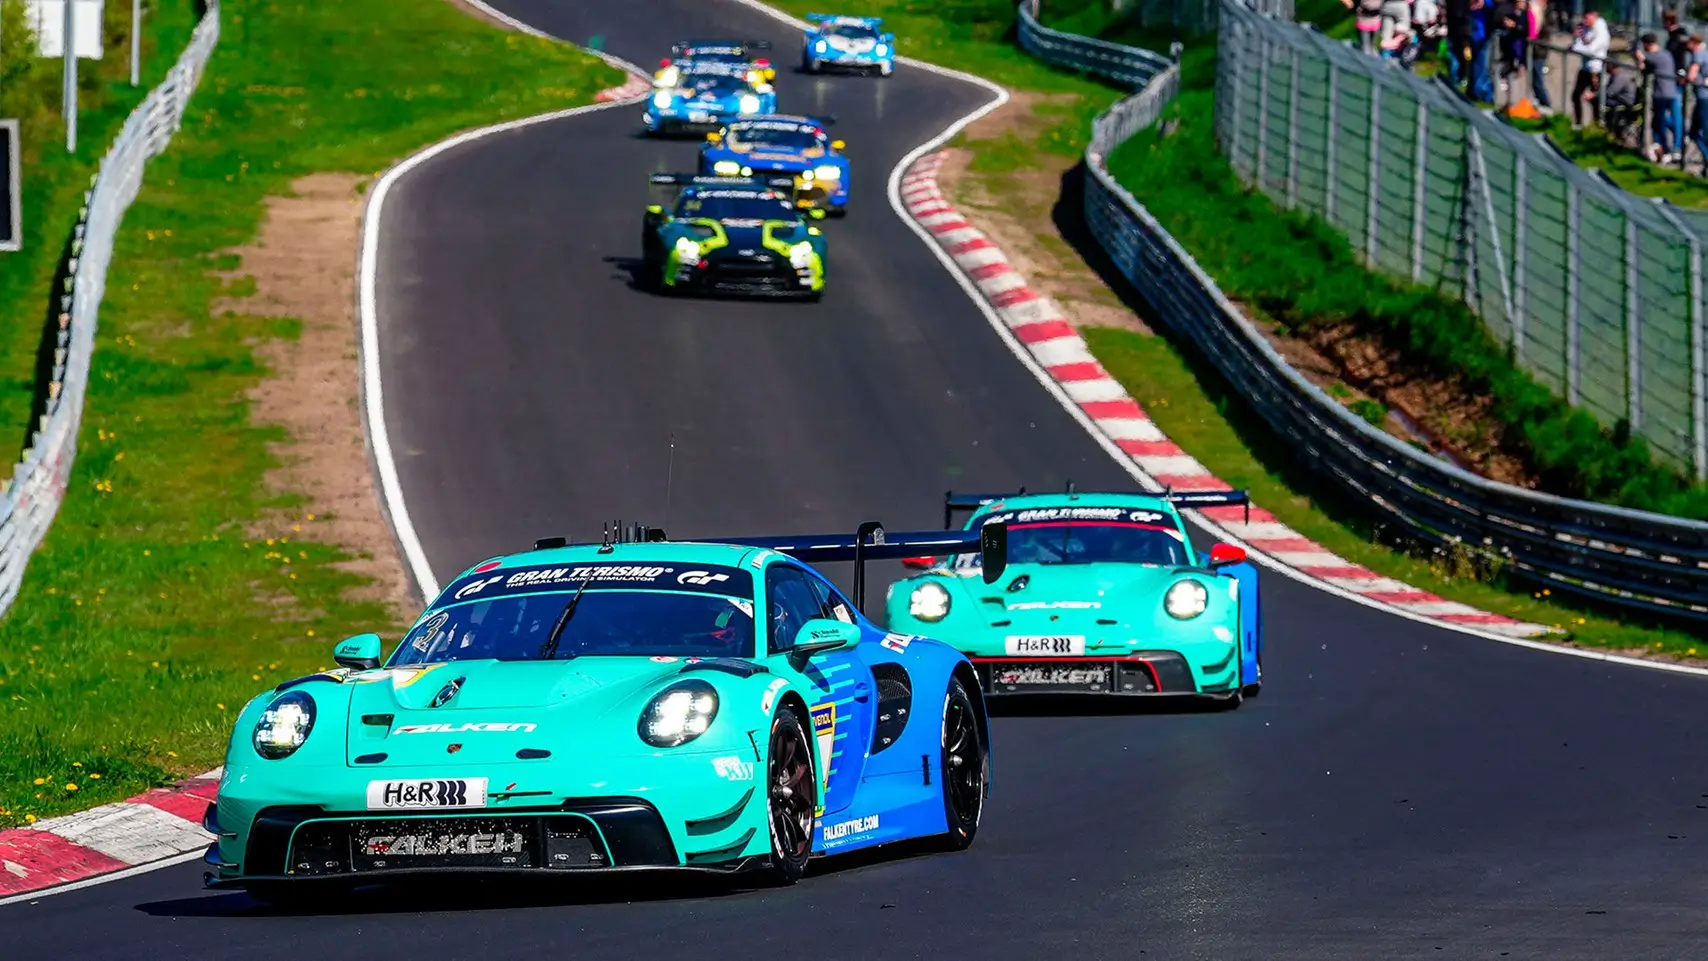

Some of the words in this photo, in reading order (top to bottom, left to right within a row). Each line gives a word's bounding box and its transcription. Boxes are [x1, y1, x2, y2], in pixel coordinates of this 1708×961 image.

[506, 568, 569, 584] GRAN
[412, 612, 449, 652] 3
[1017, 637, 1050, 651] H&R
[392, 722, 537, 735] FALKEN
[384, 781, 438, 805] H&R
[823, 814, 879, 841] FALKENTYRE.COM
